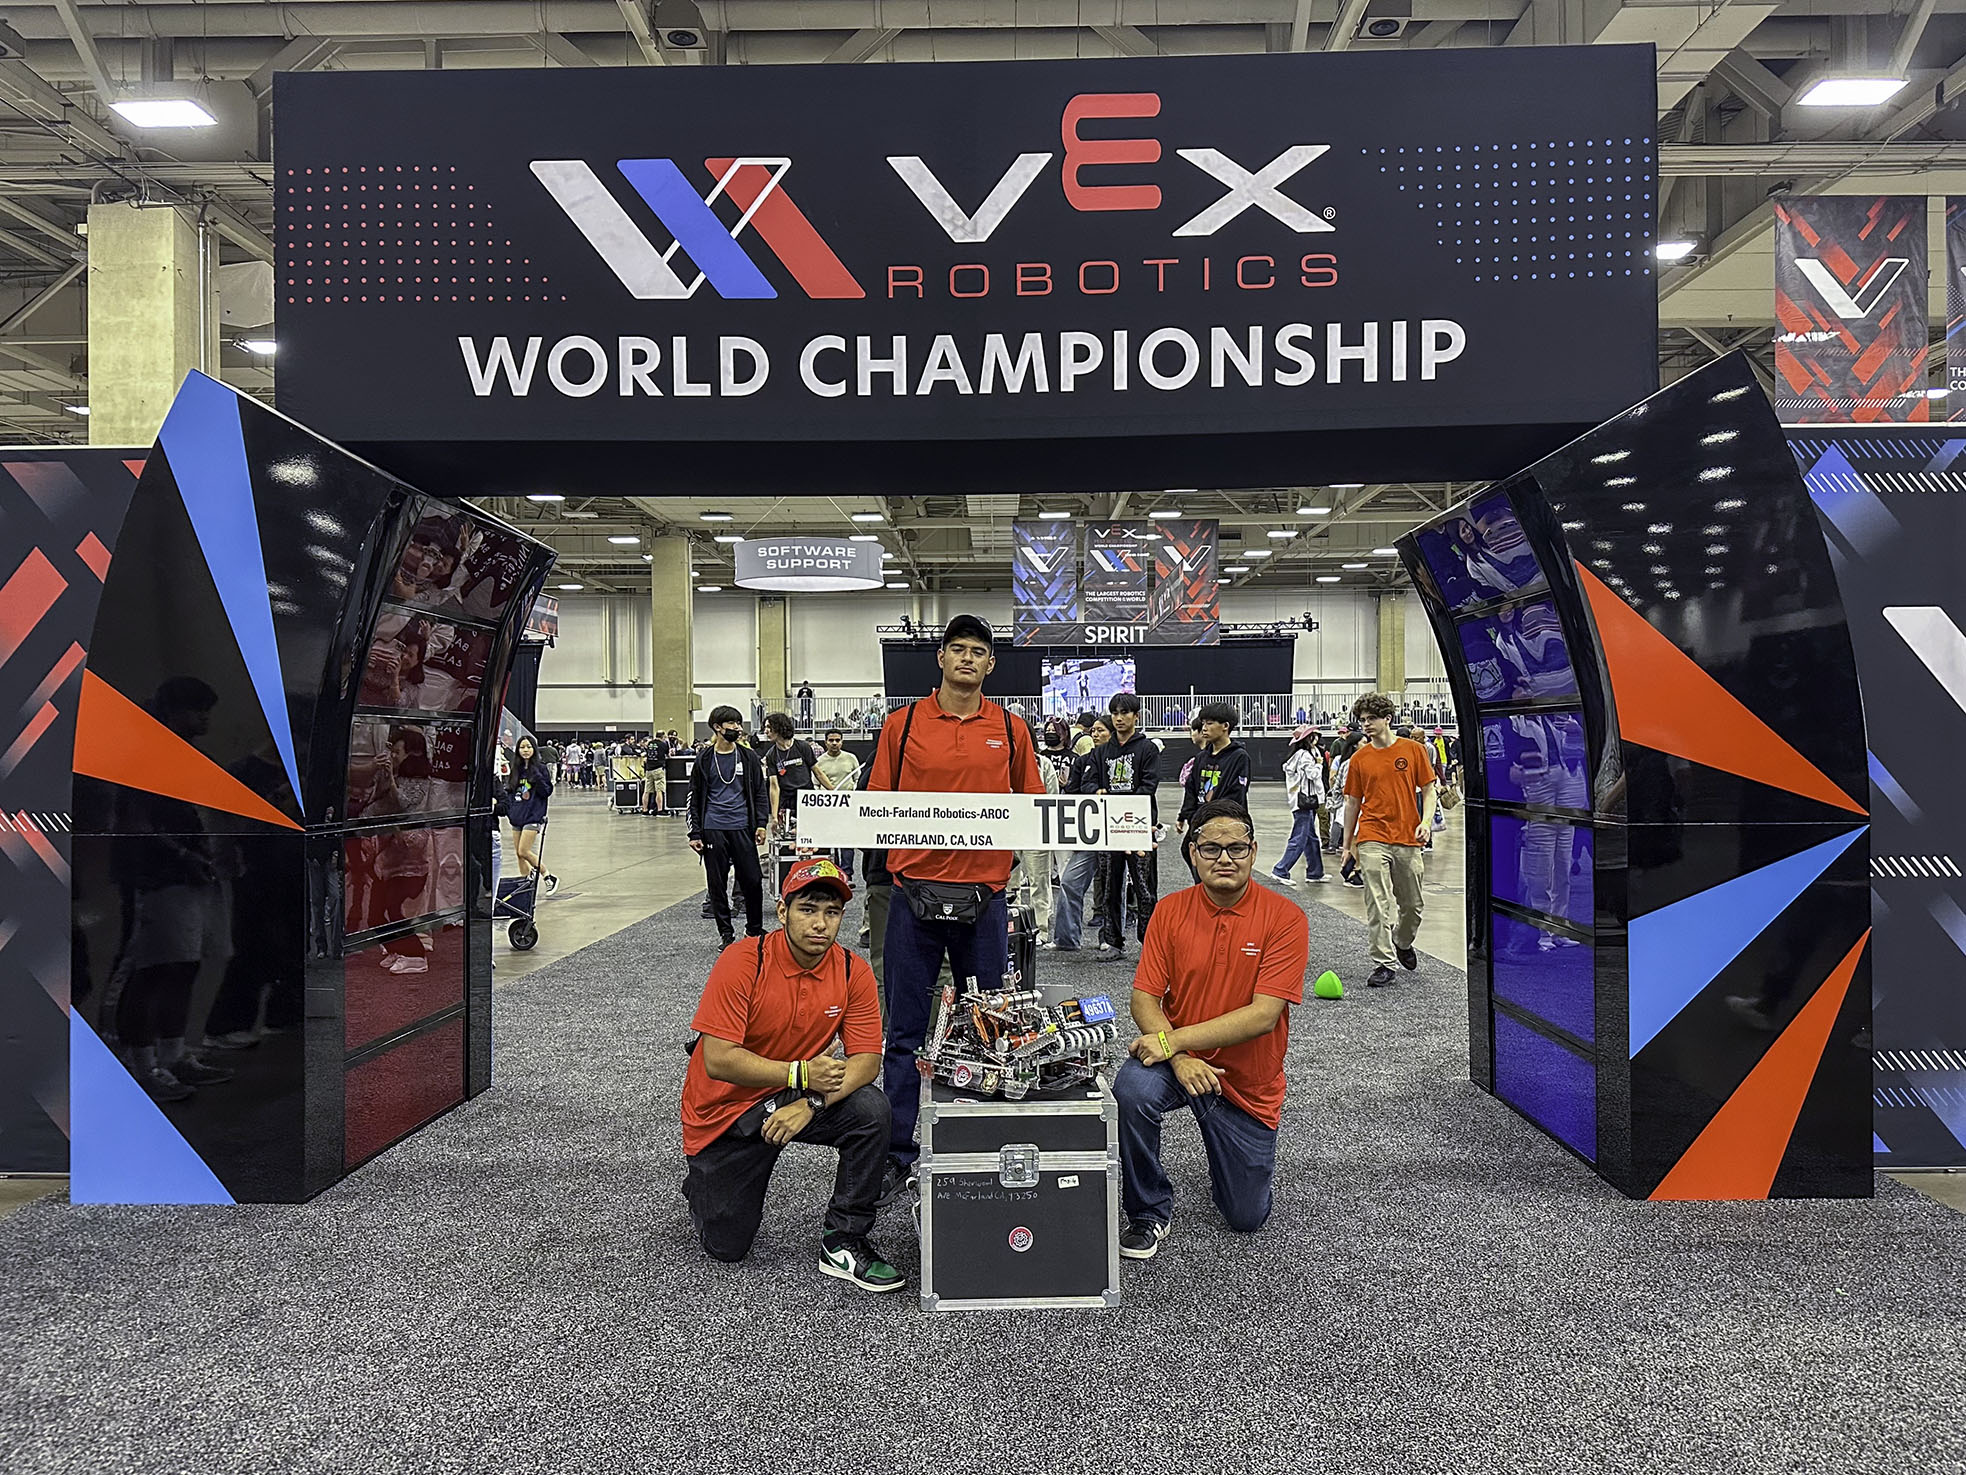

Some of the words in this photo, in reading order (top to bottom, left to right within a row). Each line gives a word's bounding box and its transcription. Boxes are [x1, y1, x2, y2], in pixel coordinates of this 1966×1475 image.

[887, 254, 1340, 299] ROBOTICS
[458, 335, 770, 398] WORLD
[799, 318, 1468, 398] CHAMPIONSHIP
[757, 545, 857, 558] SOFTWARE
[766, 558, 852, 570] SUPPORT
[1084, 625, 1148, 644] SPIRIT
[859, 806, 931, 818] Mech-Farland
[933, 807, 1010, 820] Robotics-AROC
[1110, 812, 1147, 825] VEX
[1034, 798, 1100, 845] TEC
[876, 833, 948, 846] MCFARLAND,
[950, 834, 968, 846] CA,
[970, 835, 993, 846] USA
[1083, 1001, 1114, 1017] 49637A
